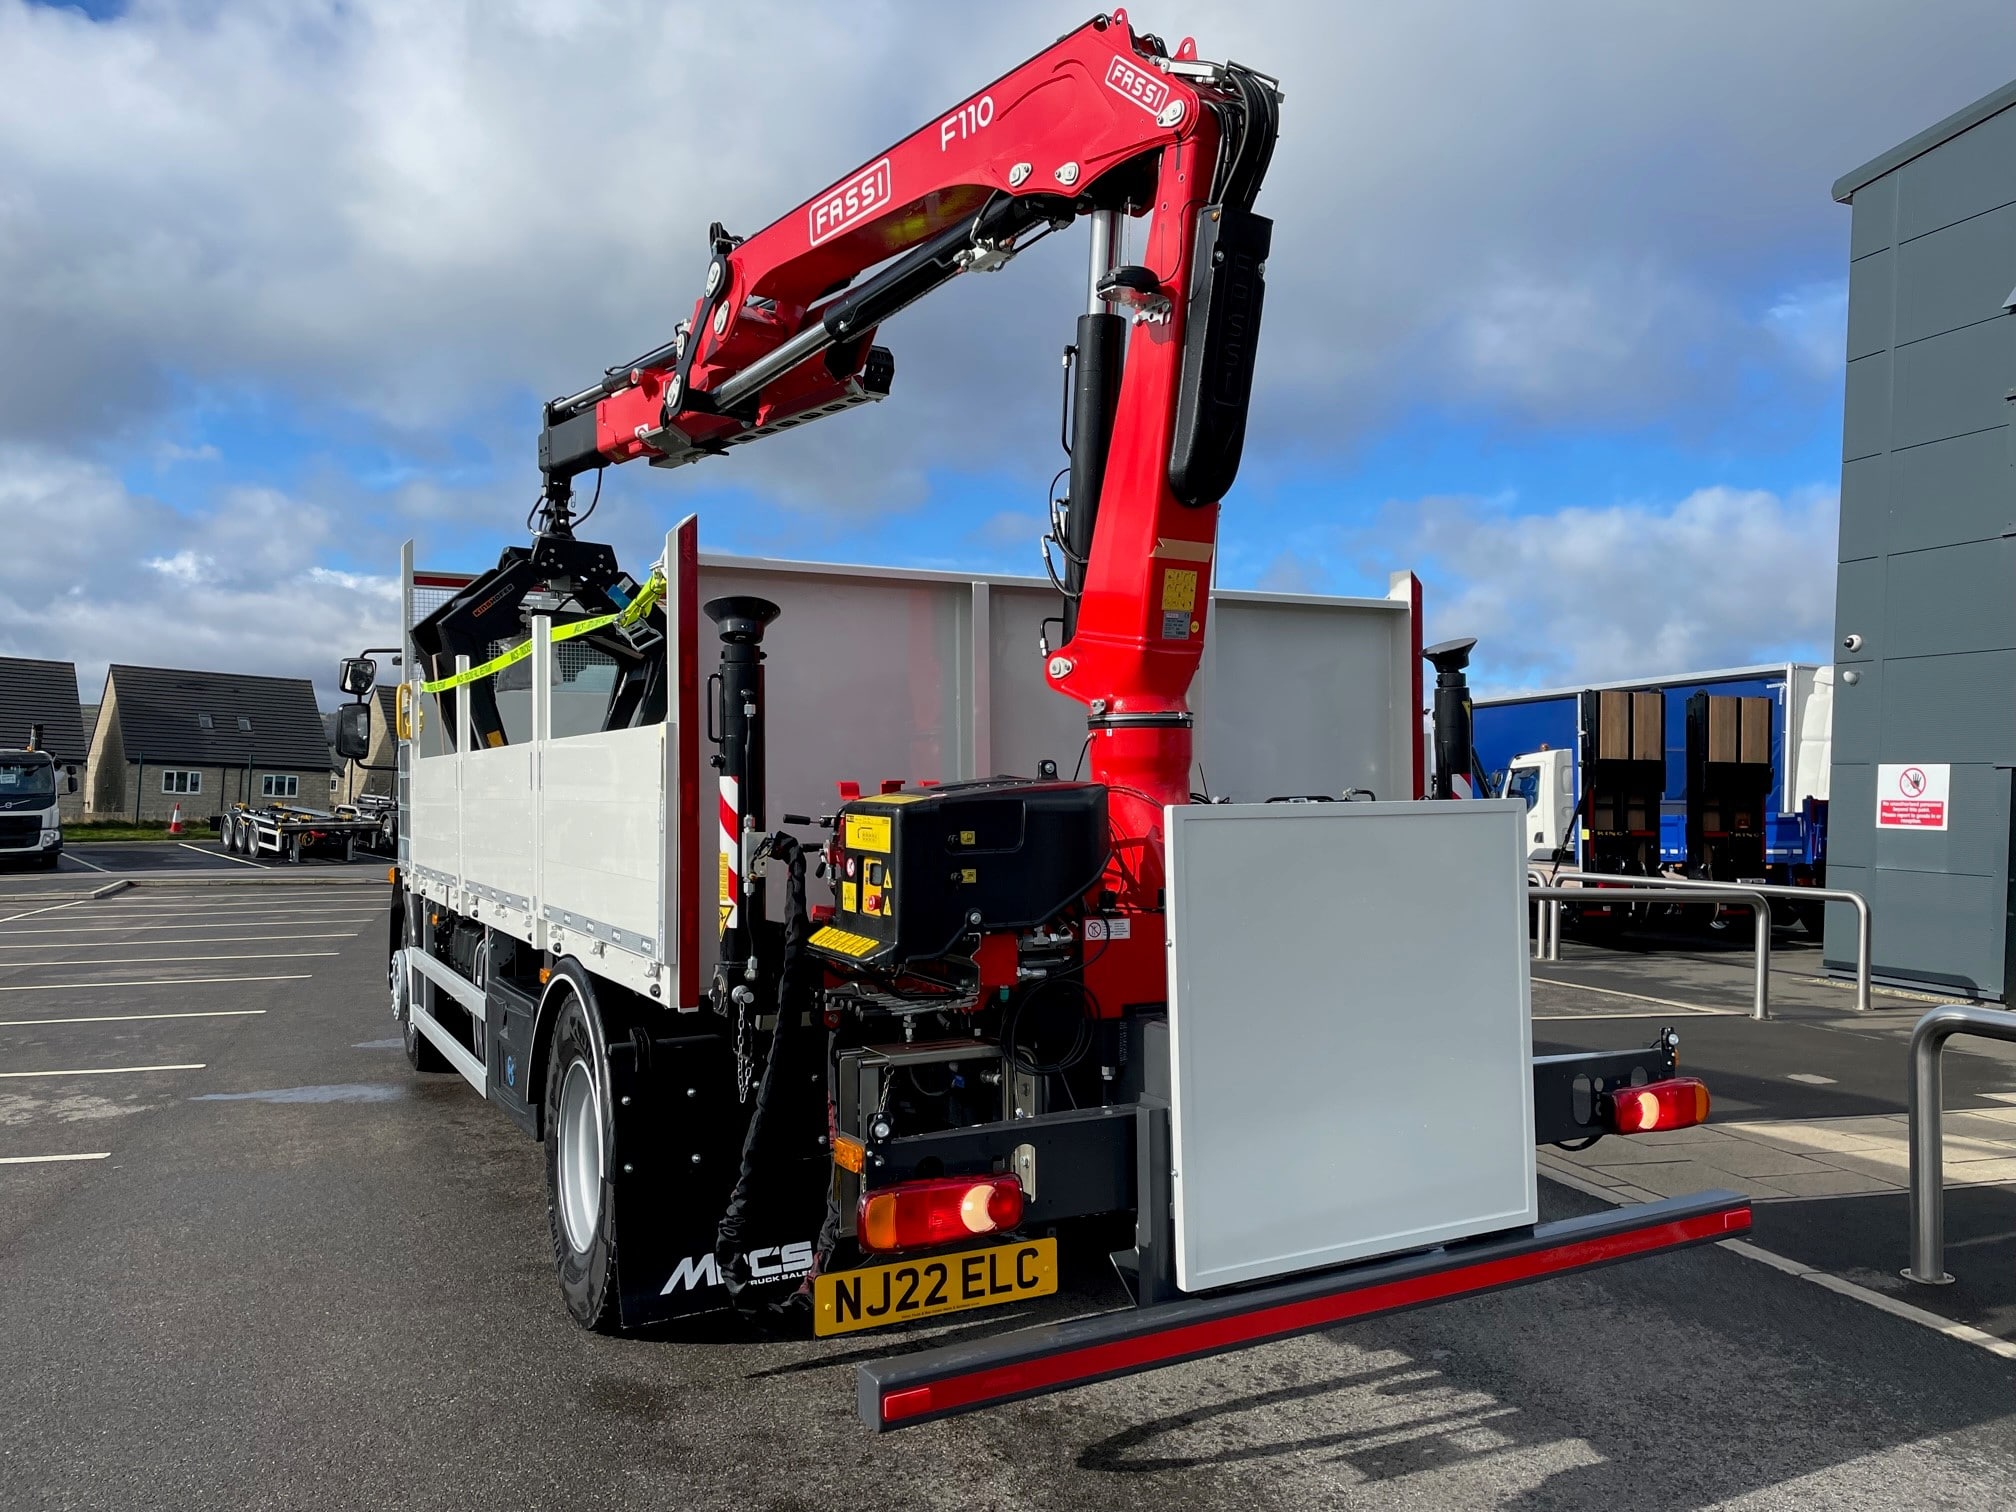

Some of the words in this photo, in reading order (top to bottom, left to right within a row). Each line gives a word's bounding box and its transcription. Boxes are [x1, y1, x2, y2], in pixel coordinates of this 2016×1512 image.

[1110, 62, 1166, 110] FASSI
[940, 95, 994, 152] F110
[816, 170, 885, 236] FASSI
[749, 1274, 780, 1287] RUCK
[835, 1262, 949, 1324] NJ22
[961, 1247, 1040, 1301] ELC
